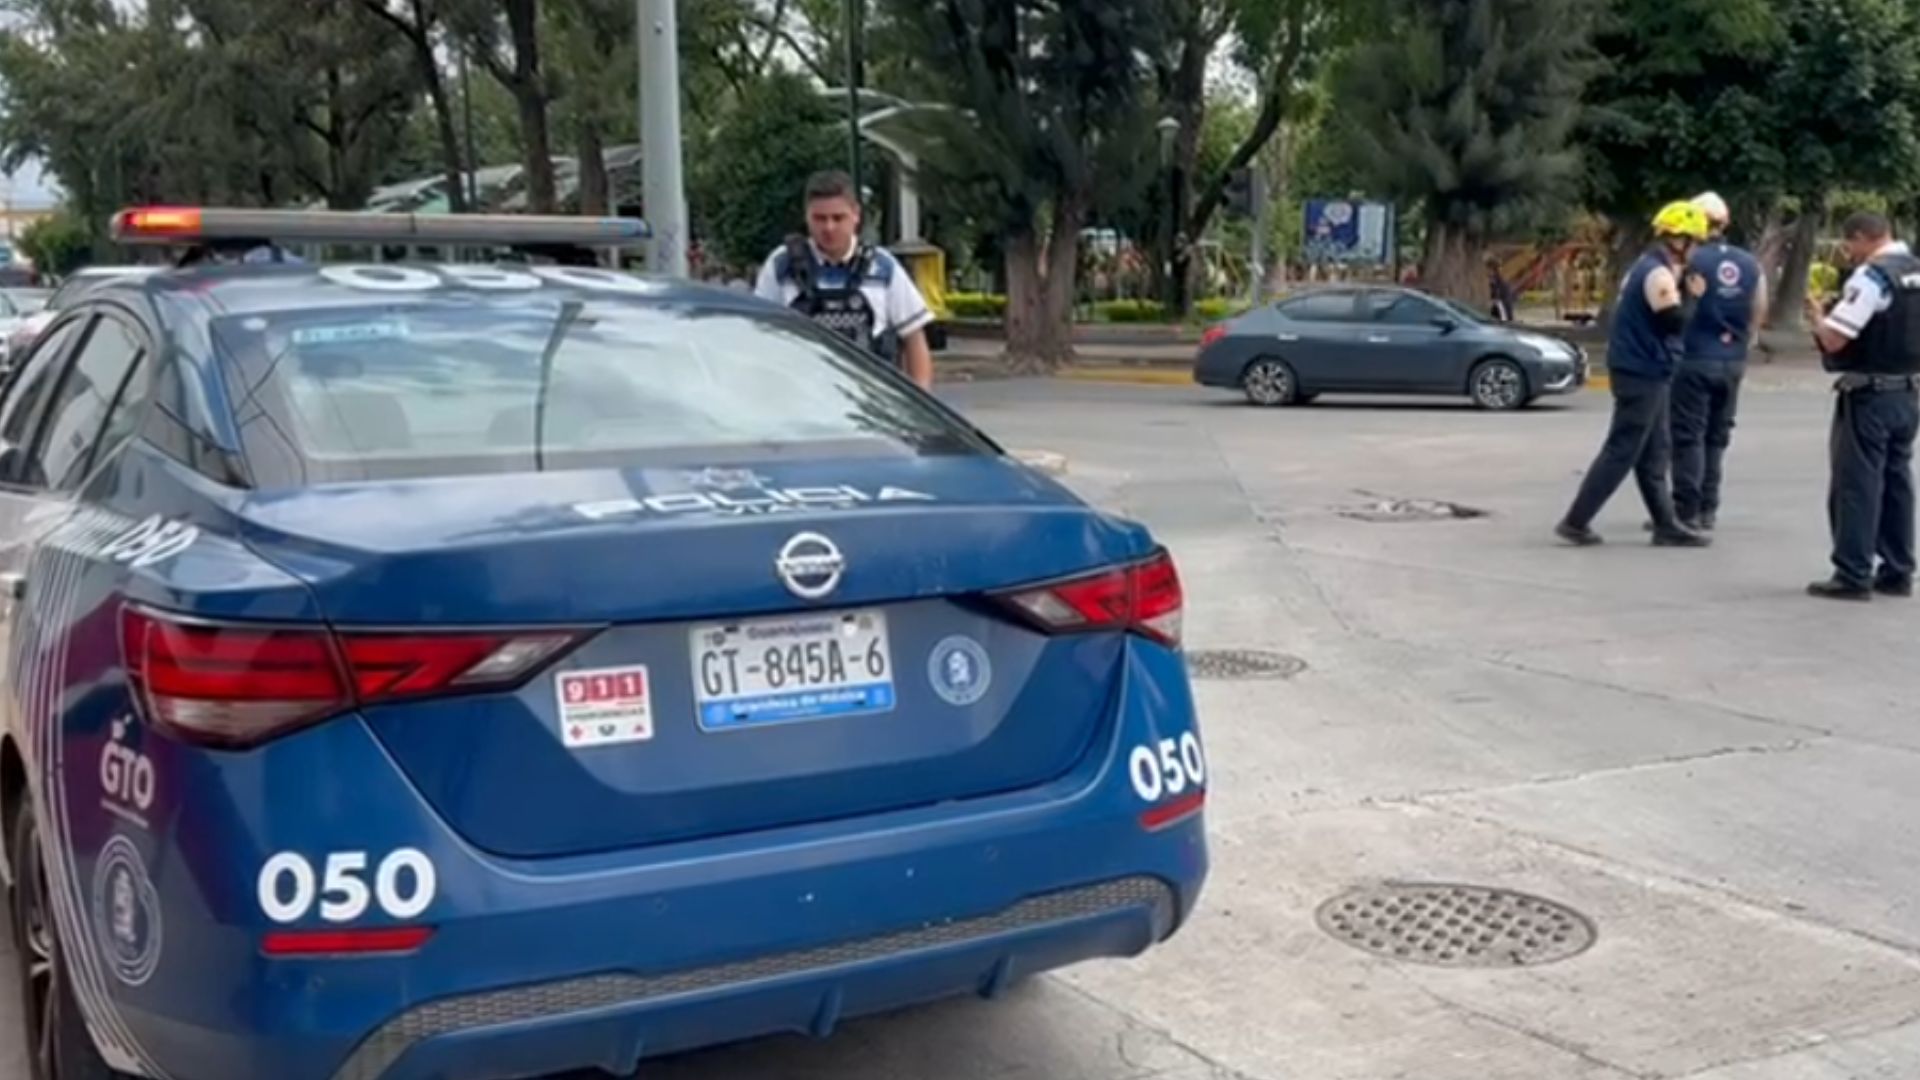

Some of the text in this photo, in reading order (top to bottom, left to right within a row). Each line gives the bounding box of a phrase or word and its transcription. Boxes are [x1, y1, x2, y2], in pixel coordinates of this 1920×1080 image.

[319, 263, 662, 291] 050
[572, 484, 937, 520] POLICIA
[99, 513, 199, 569] 050
[567, 675, 635, 701] 911
[701, 636, 885, 697] GT-845A-6
[101, 740, 155, 811] GTO
[1129, 731, 1204, 801] 050
[257, 847, 436, 923] 050
